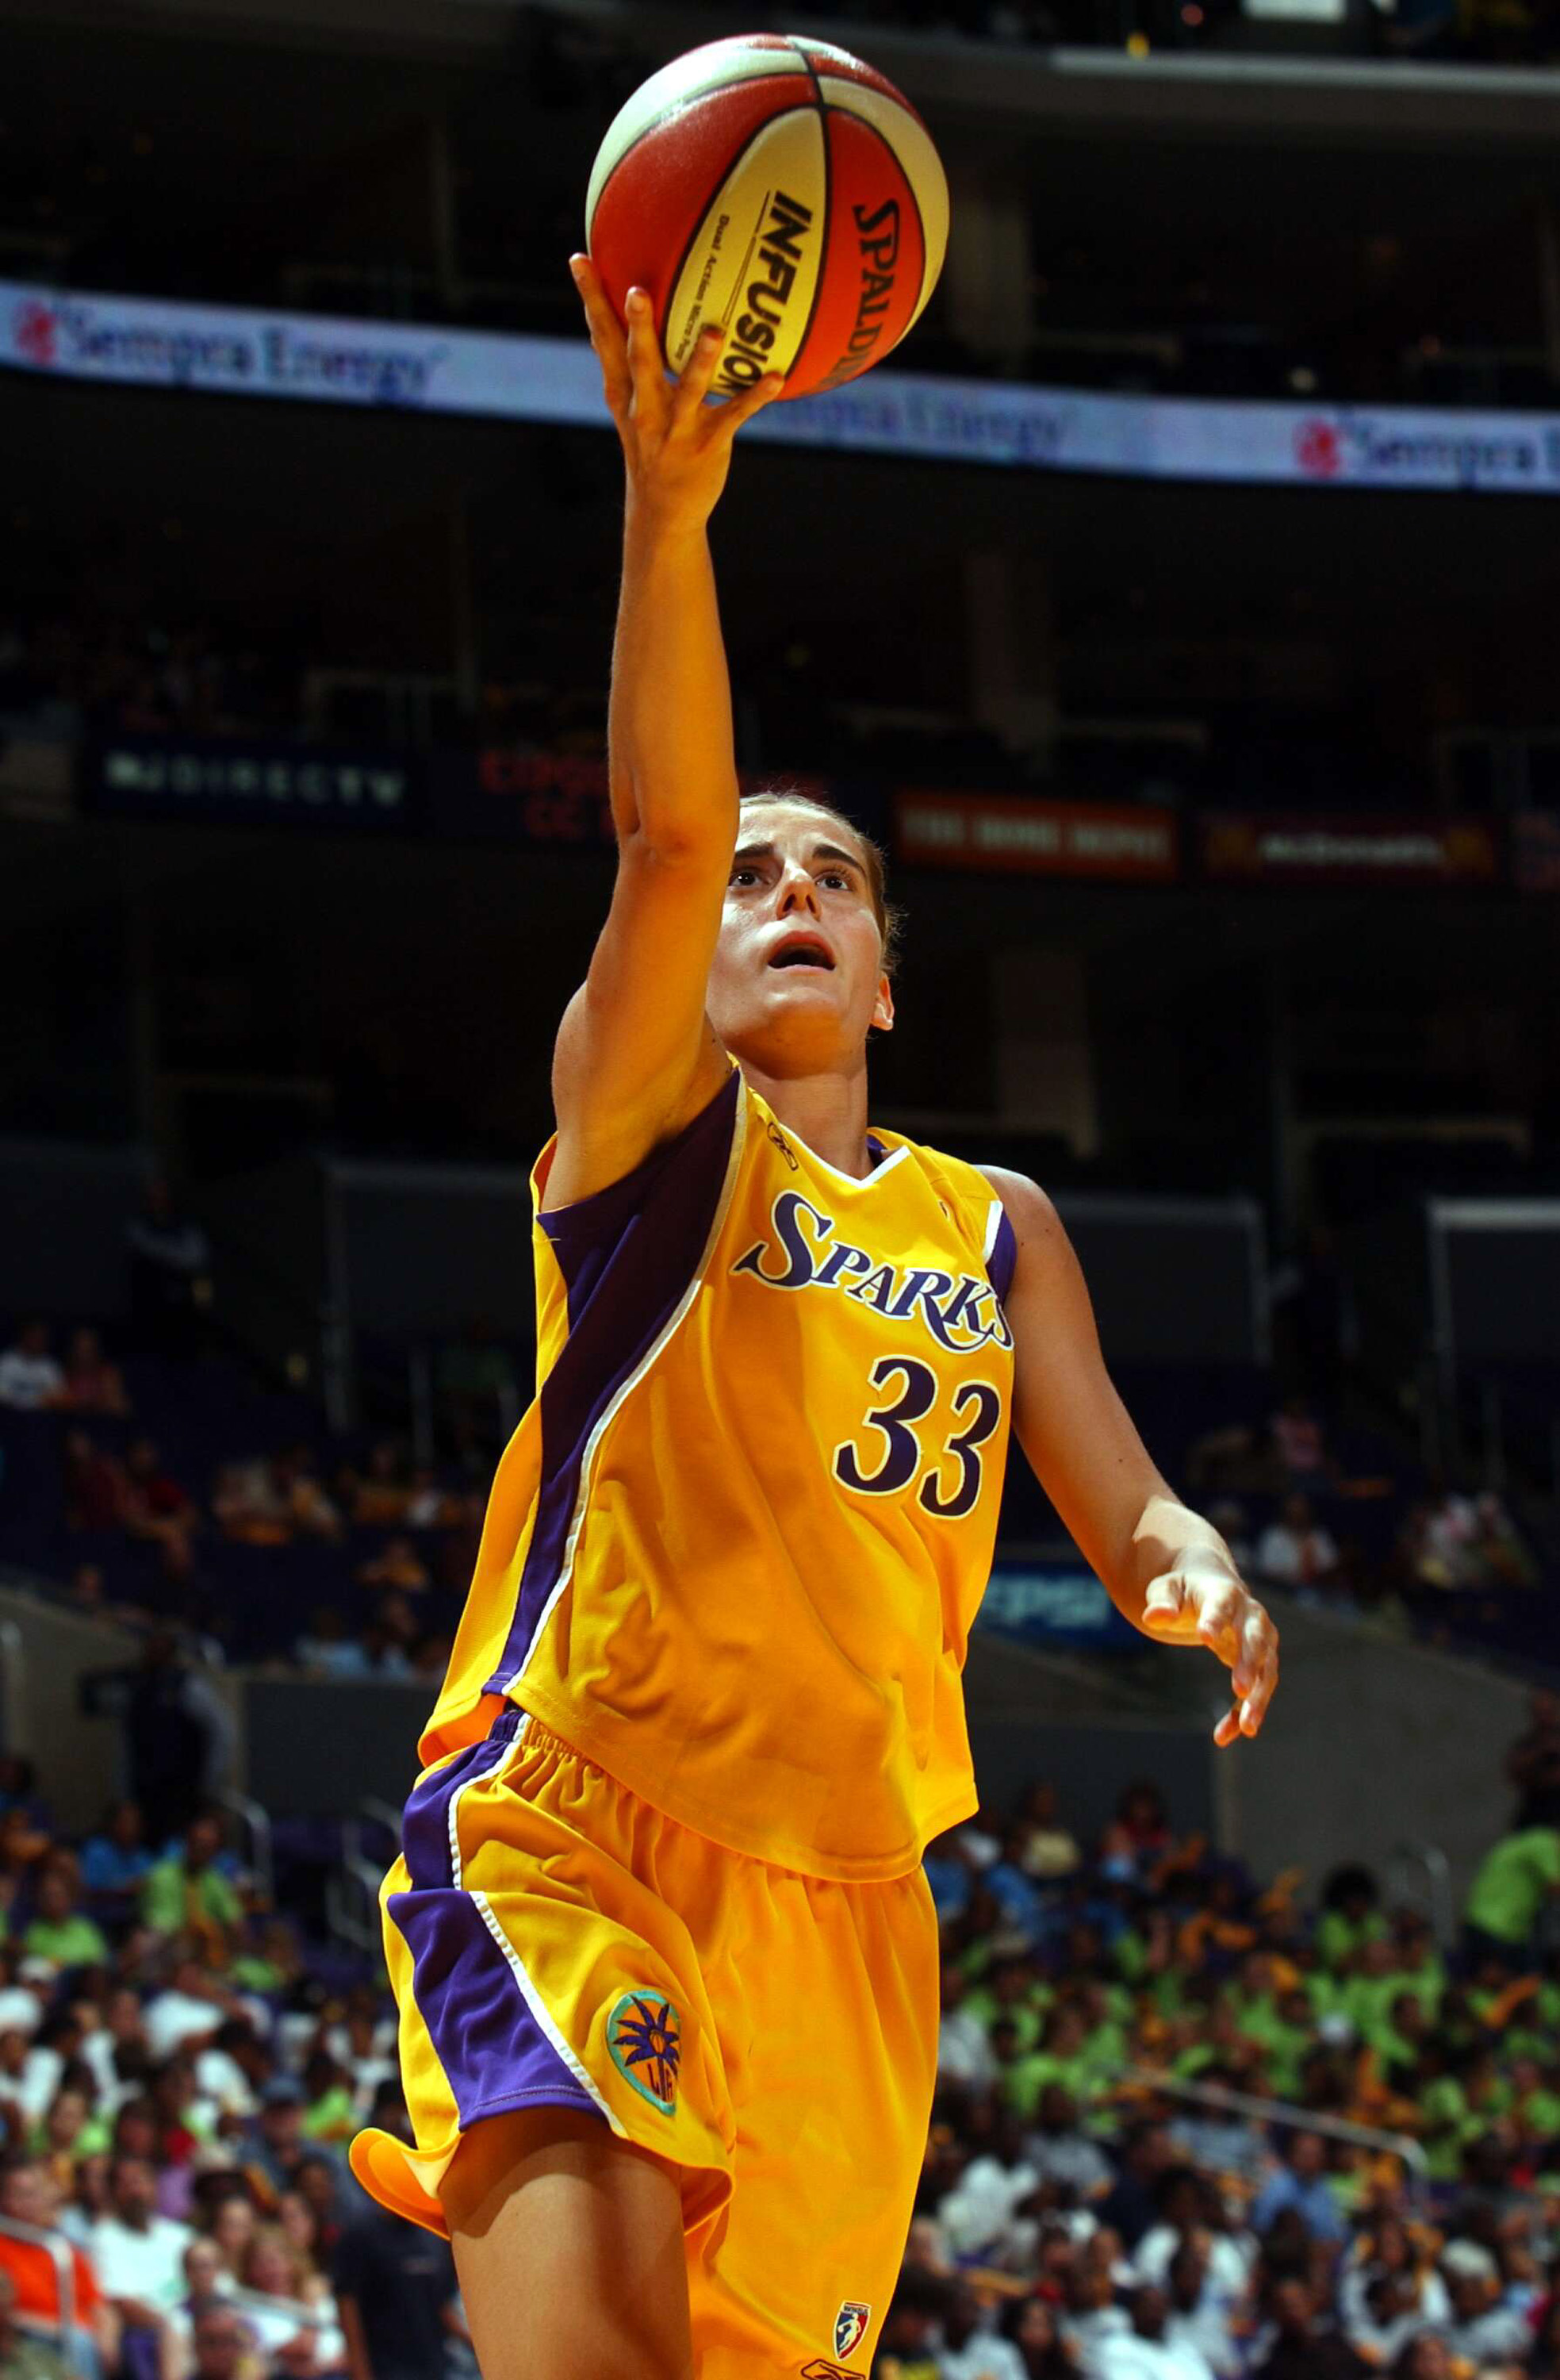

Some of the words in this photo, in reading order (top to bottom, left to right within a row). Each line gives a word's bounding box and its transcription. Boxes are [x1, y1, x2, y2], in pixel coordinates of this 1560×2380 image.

[696, 253, 717, 301] Action
[711, 213, 730, 251] Dual
[730, 1189, 1014, 1353] SPARKS
[832, 1353, 1001, 1520] 33
